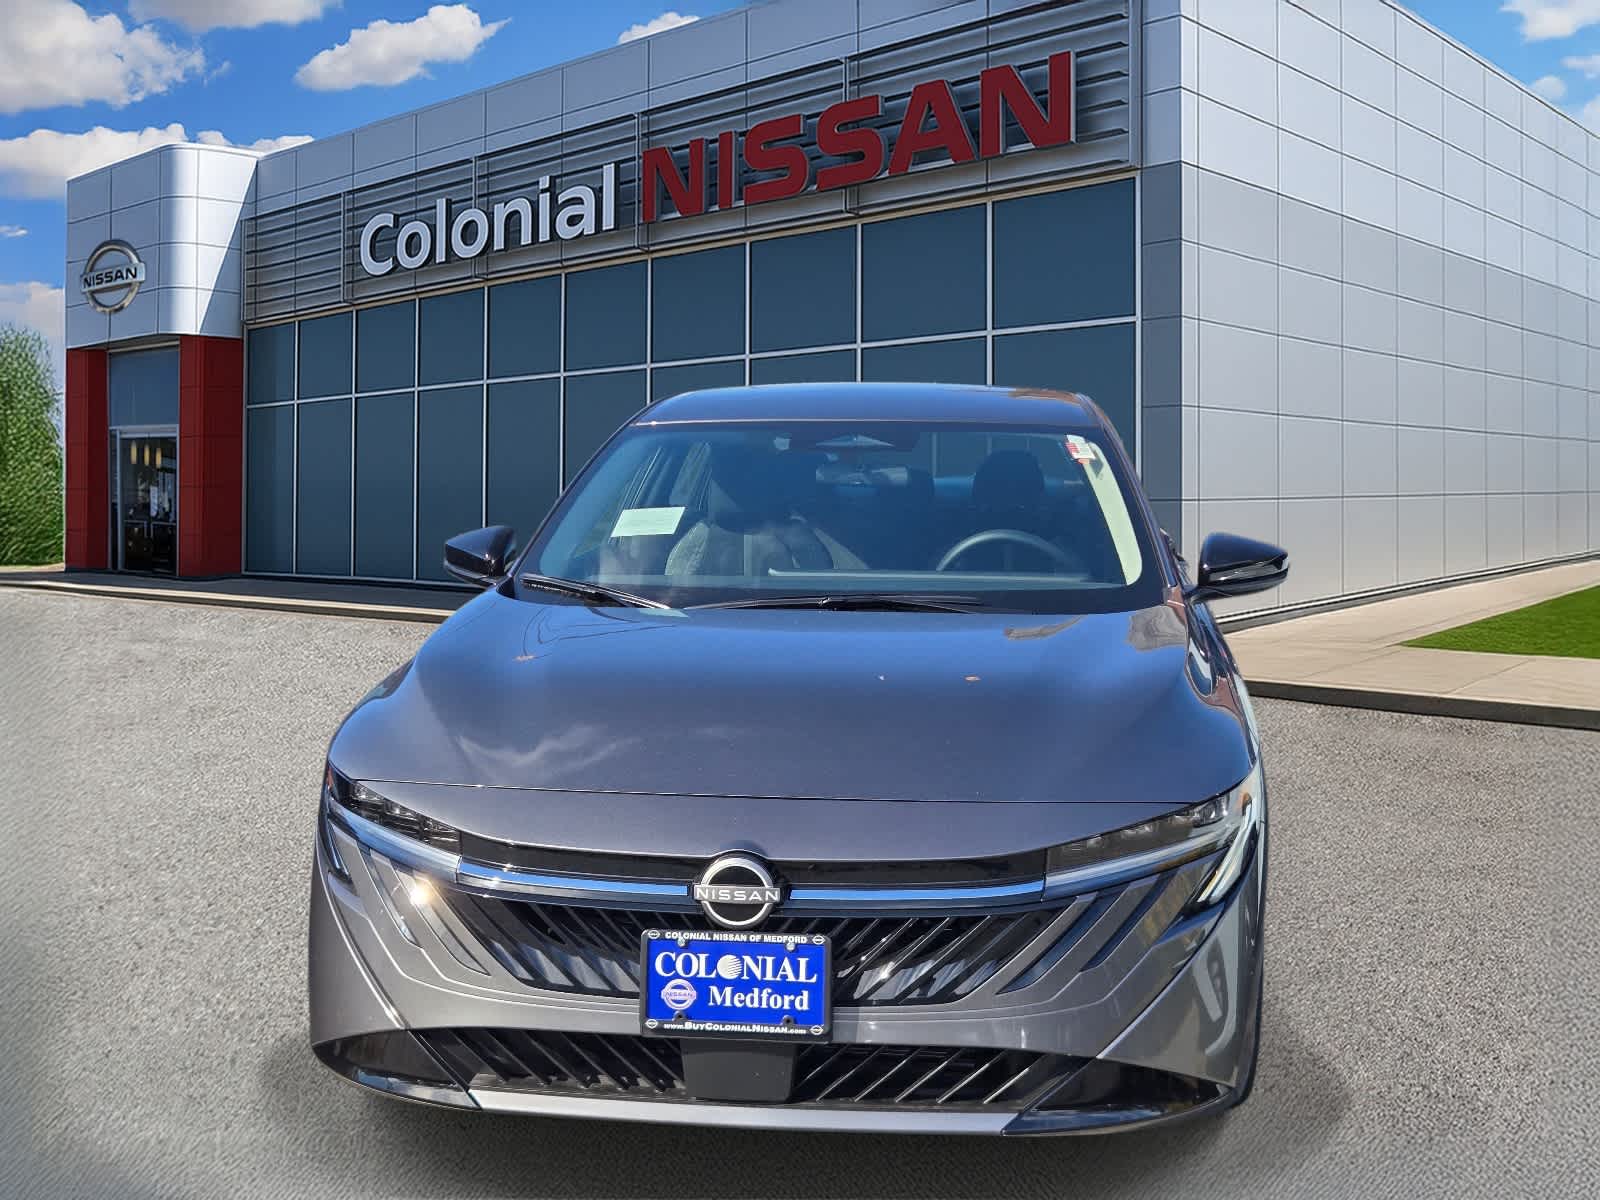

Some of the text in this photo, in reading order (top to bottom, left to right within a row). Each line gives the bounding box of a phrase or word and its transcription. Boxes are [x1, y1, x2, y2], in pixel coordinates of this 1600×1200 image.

[358, 50, 1076, 276] Colonial NISSAN
[83, 266, 138, 288] NISSAN
[695, 887, 780, 901] NISSAN
[665, 931, 711, 941] COLONIAL
[713, 934, 747, 942] NISSAN
[763, 935, 808, 944] MEDFORD
[655, 951, 817, 983] COLONIAL
[708, 985, 810, 1011] Medford
